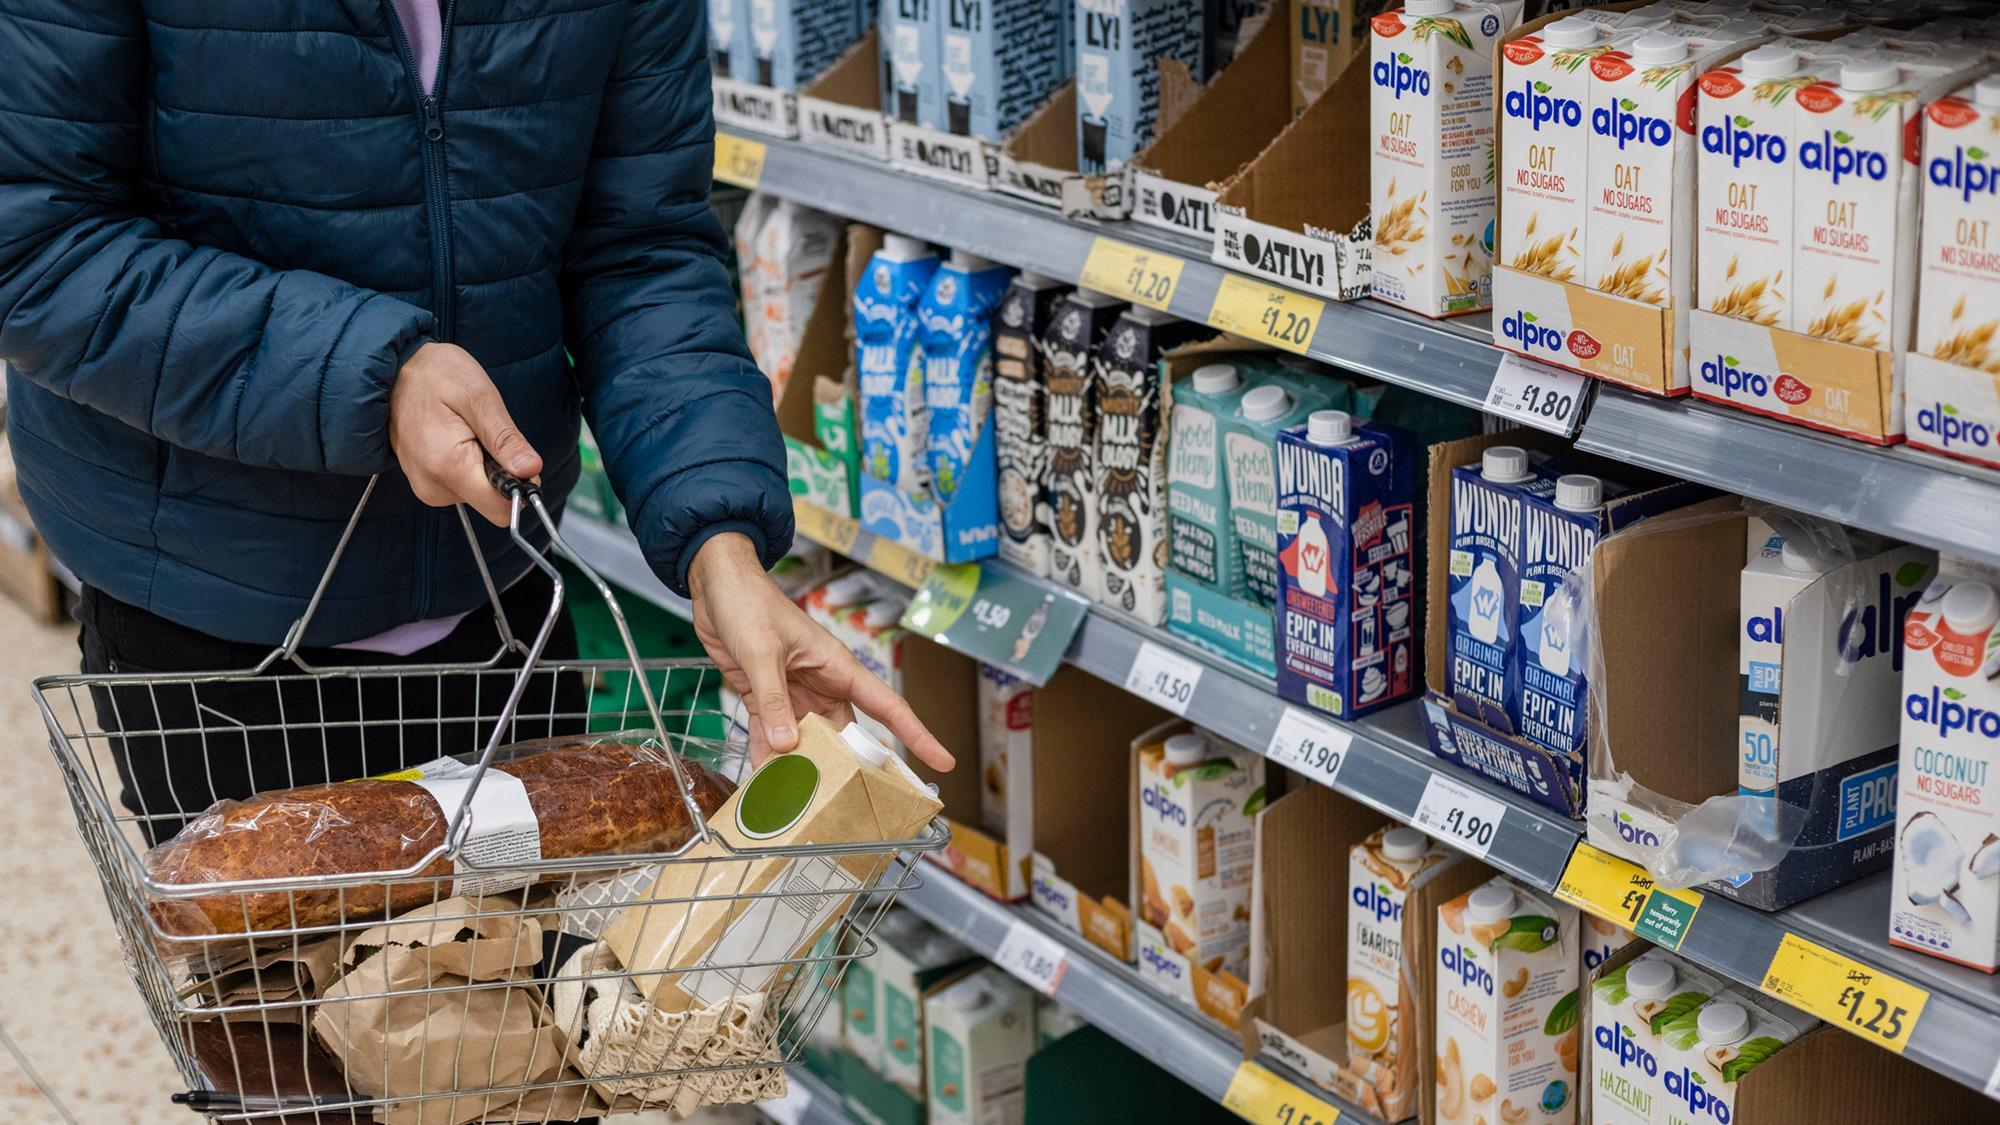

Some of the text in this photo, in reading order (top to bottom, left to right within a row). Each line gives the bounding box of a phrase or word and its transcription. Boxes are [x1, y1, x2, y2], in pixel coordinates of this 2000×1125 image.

[951, 0, 981, 32] LY!
[1086, 12, 1120, 50] LY!
[1302, 6, 1339, 44] LY!
[1374, 52, 1430, 100] alpro
[1505, 80, 1582, 131] alpro
[1390, 112, 1412, 138] OAT
[1592, 98, 1672, 150] alpro
[1702, 114, 1787, 168] alpro
[1381, 136, 1416, 158] NO SUGARS
[1528, 144, 1556, 173] OAT
[1800, 130, 1888, 185] alpro
[1451, 164, 1470, 178] GOOD
[1451, 178, 1481, 192] FOR YOU
[1517, 168, 1565, 193] NO SUGARS
[1614, 163, 1641, 193] OAT
[1930, 145, 2000, 203] alpr
[1603, 189, 1652, 214] NO SUGARS
[1728, 182, 1758, 212] OAT
[1827, 200, 1858, 229] OAT
[1224, 229, 1238, 241] THE
[1716, 209, 1769, 234] NO SUGARS
[1813, 226, 1870, 252] NO SUGARS
[1956, 218, 1990, 248] OAT
[1244, 233, 1324, 287] OATLY!
[1941, 246, 1955, 264] NO
[1262, 305, 1310, 346] £1.20
[1503, 310, 1562, 351] alpro
[1571, 342, 1597, 358] SUGARS
[1613, 343, 1636, 366] OAT
[1701, 354, 1768, 397] alpro
[1522, 385, 1571, 420] £1.80
[1779, 386, 1806, 401] SUGARS
[1825, 388, 1850, 413] OAT
[1917, 401, 1990, 447] alpro
[1177, 450, 1213, 484] Hemp
[1277, 440, 1344, 516] WUNDA
[1235, 478, 1274, 515] Hemp
[1454, 478, 1520, 560] WUNDA
[1456, 535, 1474, 548] PLANT
[1475, 535, 1496, 550] BASED,
[1526, 505, 1595, 569] WUNDA
[1526, 565, 1567, 577] PLANT BASED
[1286, 611, 1317, 644] EPIC
[1320, 623, 1334, 650] IN
[1286, 636, 1334, 667] EVERYTHING
[1455, 634, 1504, 669] ORIGINAL
[1940, 651, 1974, 666] PERFECTION
[1942, 641, 1974, 656] CHILLED TO
[1156, 671, 1191, 703] £1.50
[1454, 657, 1503, 701] EPIC IN
[1525, 666, 1576, 703] ORIGINAL
[1754, 665, 1764, 688] PLANT
[1523, 689, 1574, 736] EPIC IN
[1906, 685, 2000, 738] alpro
[1521, 715, 1572, 752] EVERYTHING
[1300, 738, 1340, 774] £1.90
[1456, 738, 1527, 783] EVERYTHING
[1914, 747, 1989, 787] COCONUT
[1510, 780, 1531, 794] TOUT
[1917, 775, 1981, 805] NO SUGARS
[1142, 784, 1187, 828] alpro
[1845, 786, 1860, 830] PLANT
[1447, 807, 1493, 846] £1.90
[1613, 810, 1659, 847] lpro
[1853, 838, 1895, 864] PLANT-BAS
[1353, 882, 1404, 922] alpr
[1622, 890, 1646, 922] £1
[1649, 908, 1682, 928] temporarily
[1662, 903, 1678, 916] Sorry
[1644, 918, 1678, 937] out of stock
[1142, 945, 1182, 979] alpro
[1441, 944, 1493, 997] alpro
[1447, 990, 1487, 1029] CASHEW
[1838, 986, 1908, 1040] £1.25
[1595, 1021, 1658, 1077] alpro
[1600, 1068, 1652, 1117] HAZELNUT
[1664, 1067, 1730, 1125] alpro
